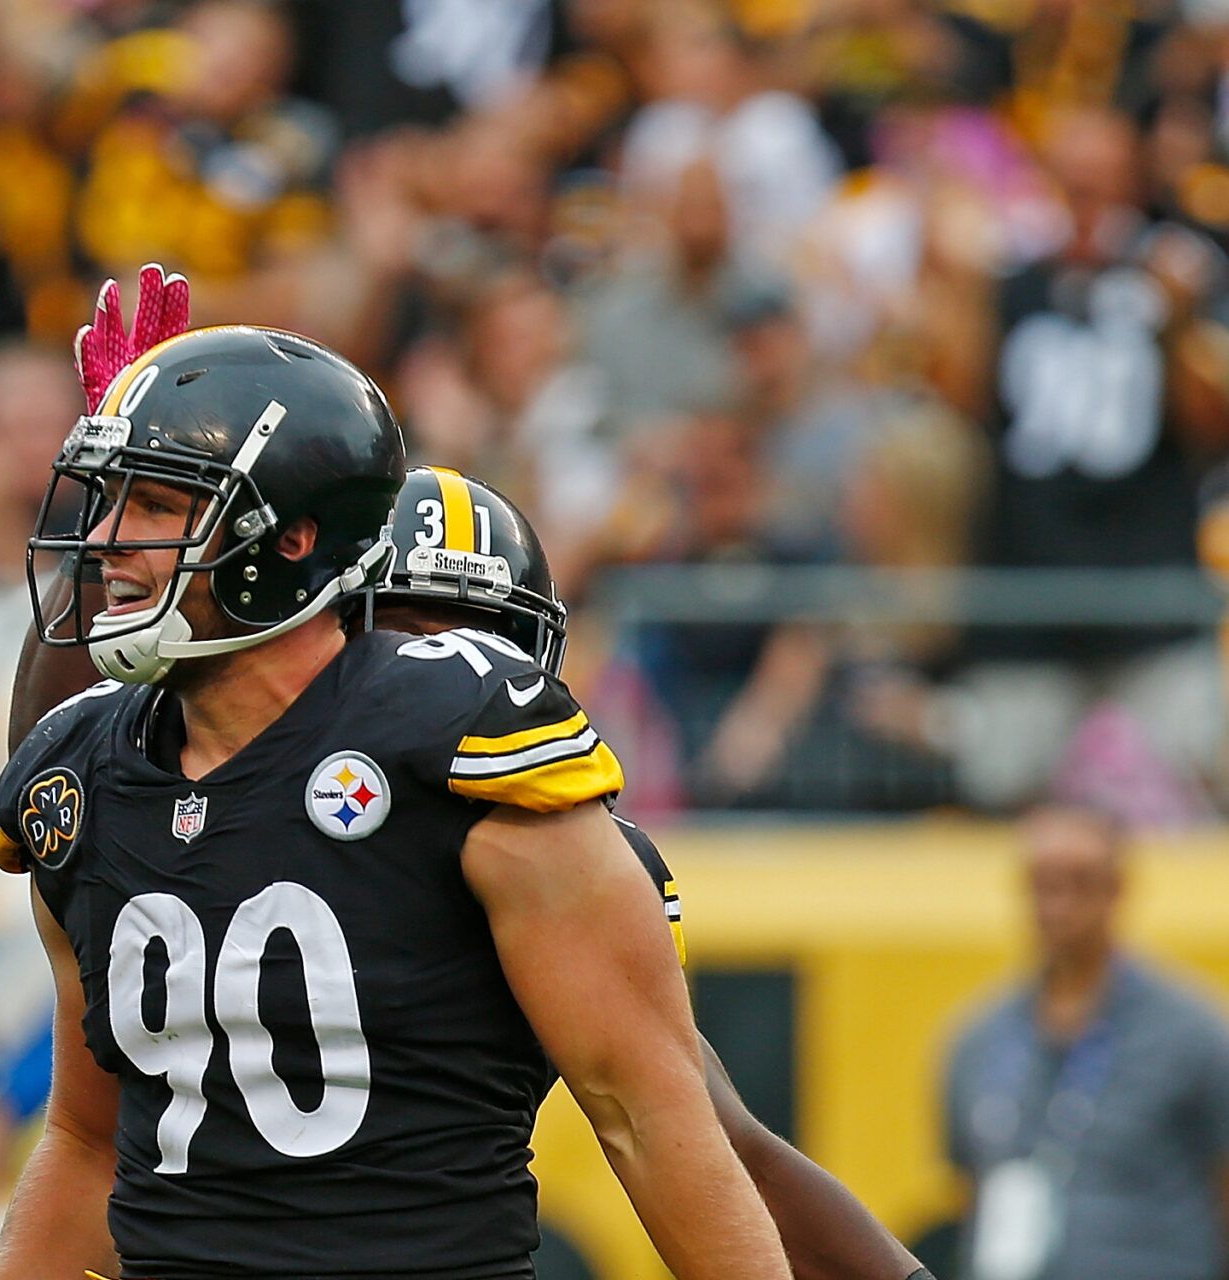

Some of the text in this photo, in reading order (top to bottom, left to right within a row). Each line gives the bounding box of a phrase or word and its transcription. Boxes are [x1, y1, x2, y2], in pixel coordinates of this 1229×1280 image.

[434, 552, 486, 576] Steelers
[313, 789, 344, 800] Steelers
[178, 814, 200, 834] NFL
[108, 881, 371, 1174] 90
